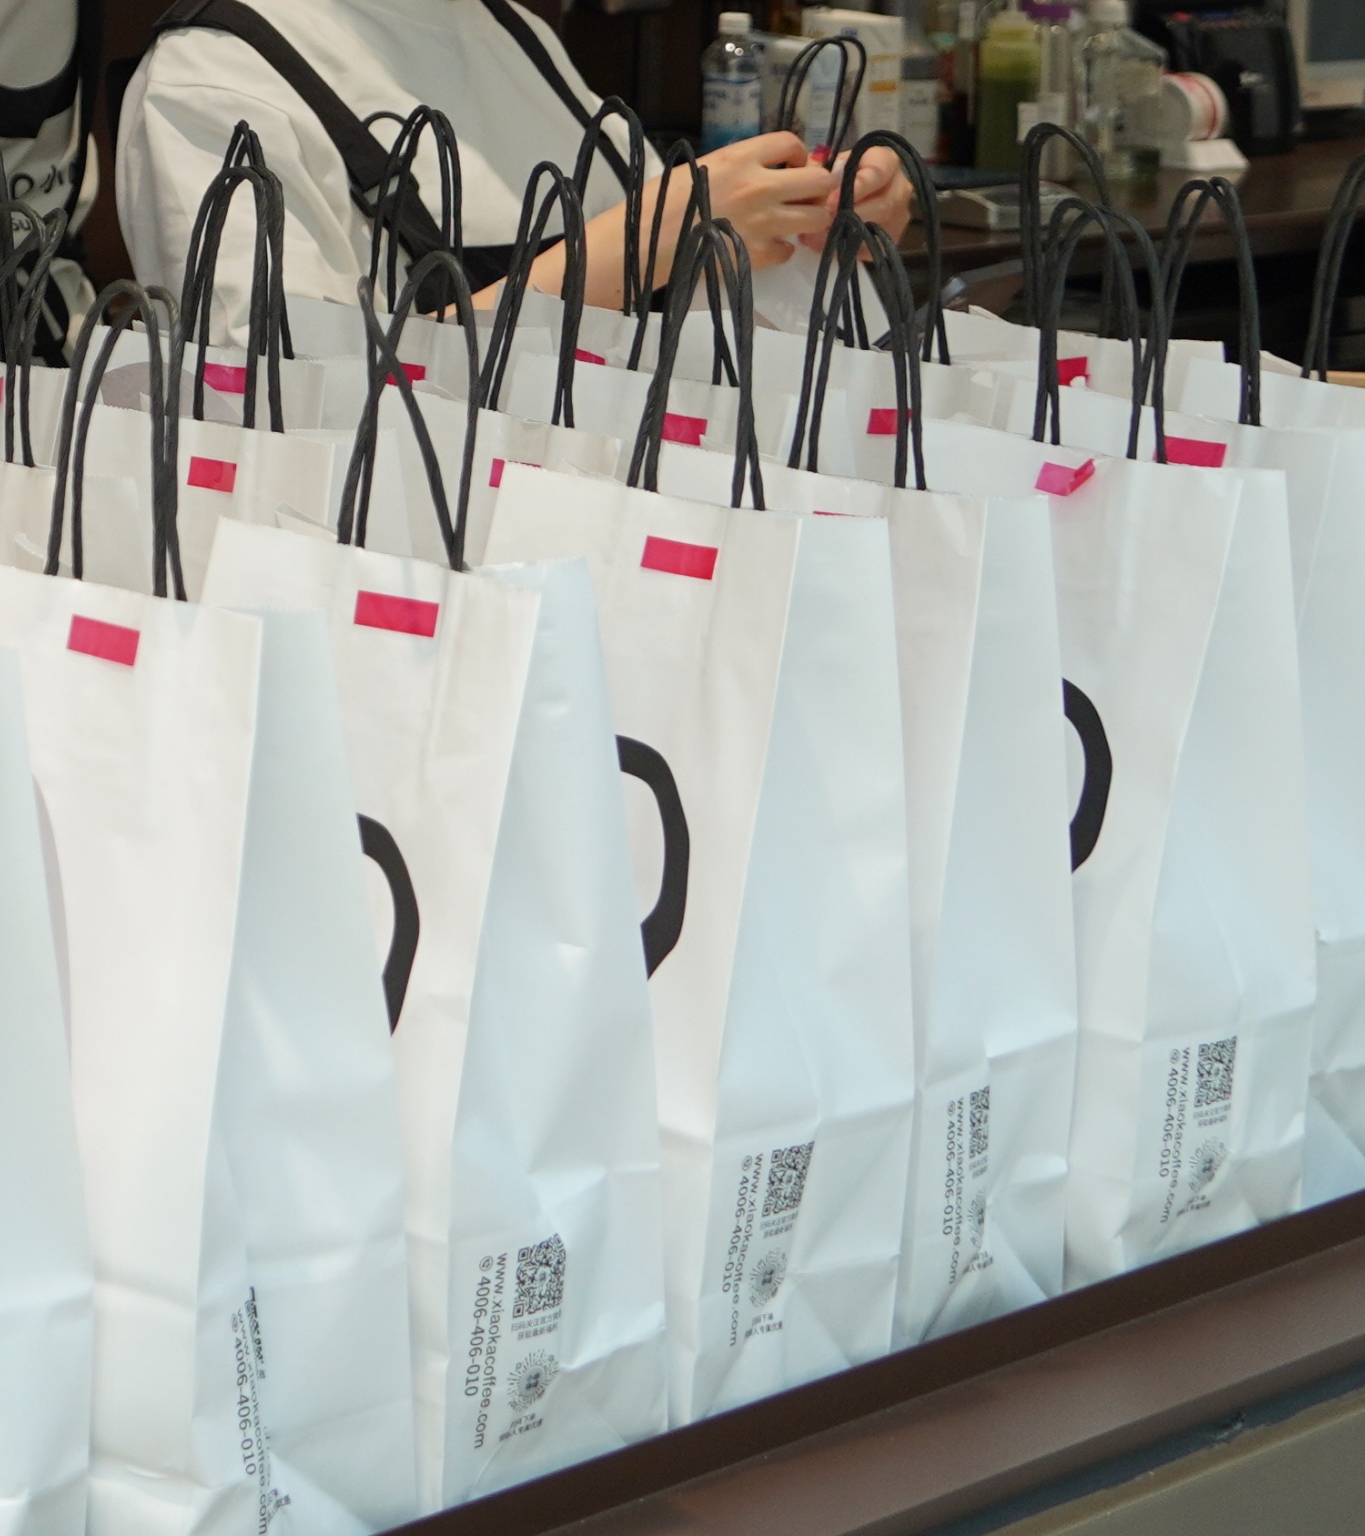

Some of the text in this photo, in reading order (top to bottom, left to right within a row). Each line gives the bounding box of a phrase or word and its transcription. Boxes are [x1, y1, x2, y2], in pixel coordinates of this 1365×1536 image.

[941, 1120, 957, 1236] 4006-406-010
[1158, 1068, 1180, 1178] 4006-406-010
[721, 1174, 751, 1294] 4006-406-010
[463, 1275, 492, 1398] 4006-406-010
[472, 1252, 508, 1450] www.xiaokacoffee.com
[233, 1335, 257, 1476] 4006-406-010
